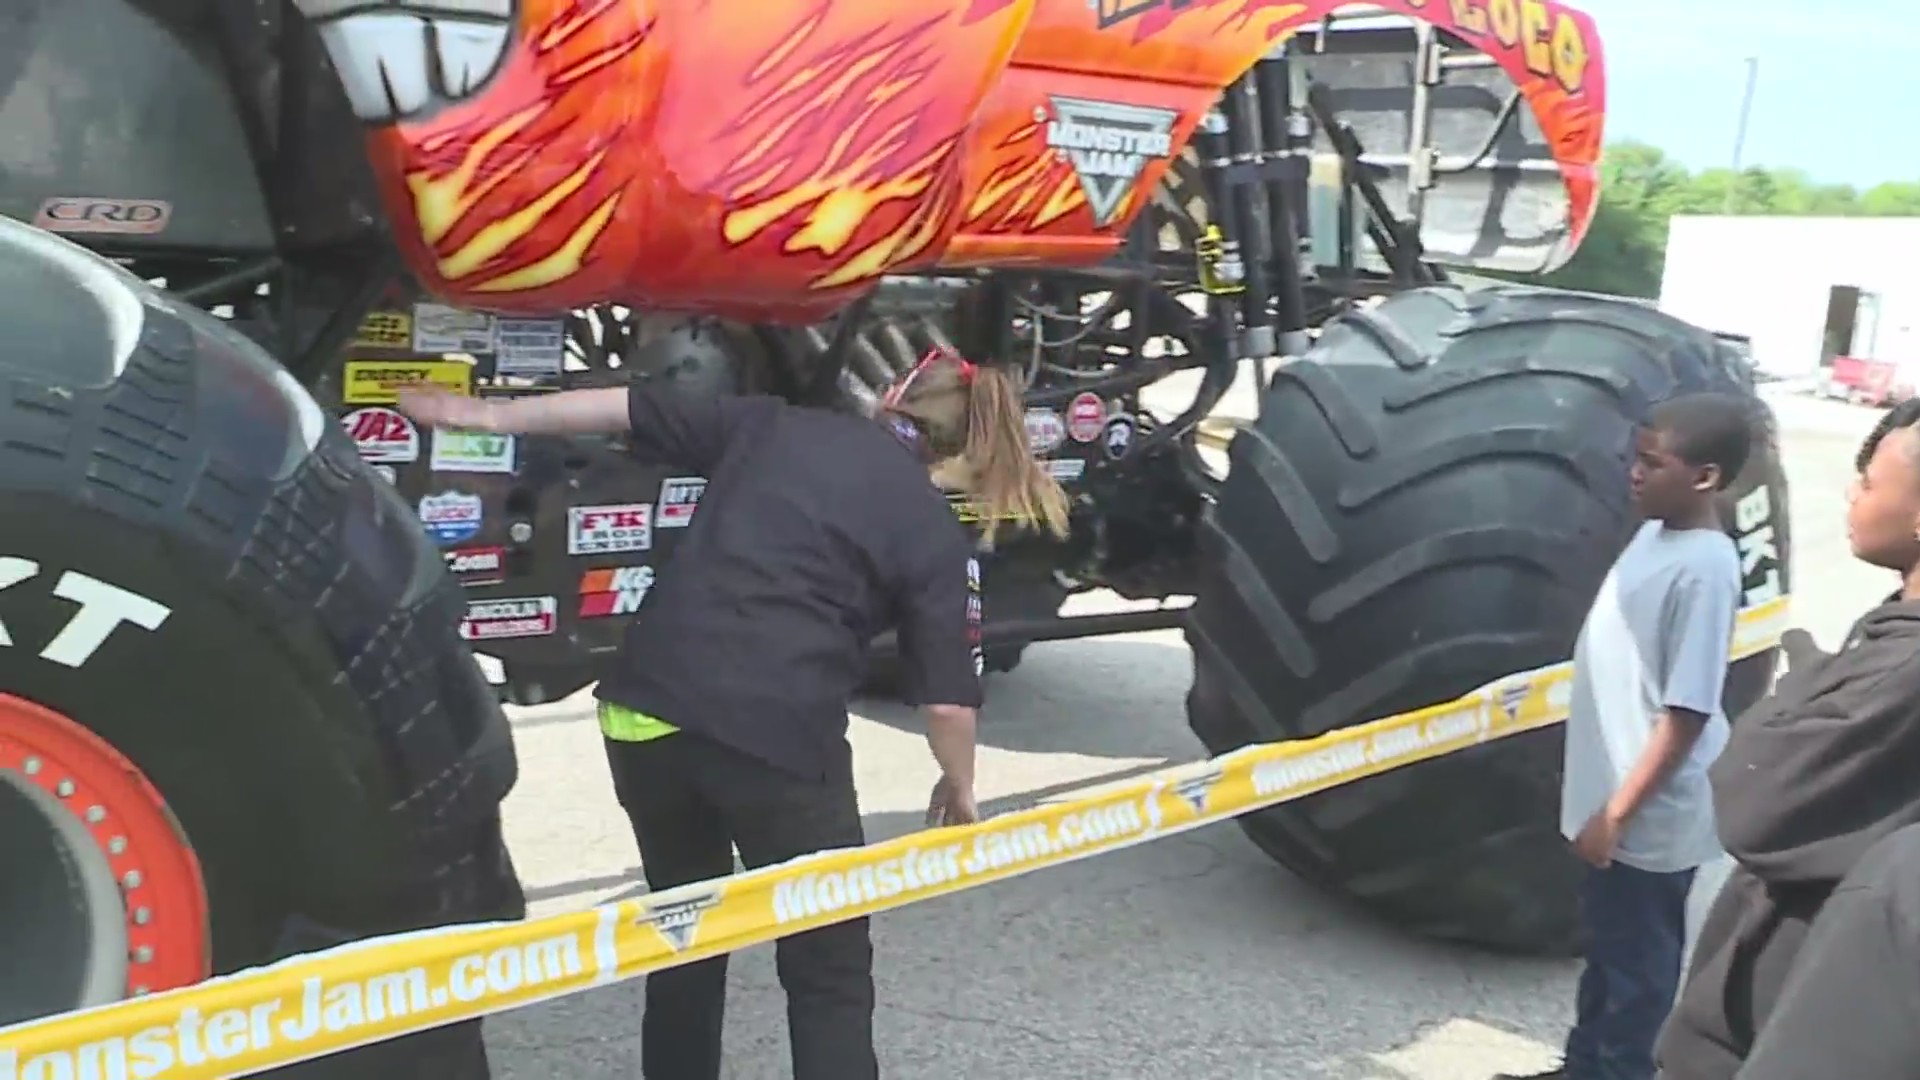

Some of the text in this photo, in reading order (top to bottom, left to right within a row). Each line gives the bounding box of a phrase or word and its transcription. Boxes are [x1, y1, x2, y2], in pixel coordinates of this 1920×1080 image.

[1047, 122, 1171, 157] MONSTER
[1078, 151, 1141, 177] JAM
[46, 202, 162, 222] CRD
[582, 511, 645, 530] FK
[1736, 484, 1781, 604] BKT
[771, 799, 1141, 924] MonsterJam.com
